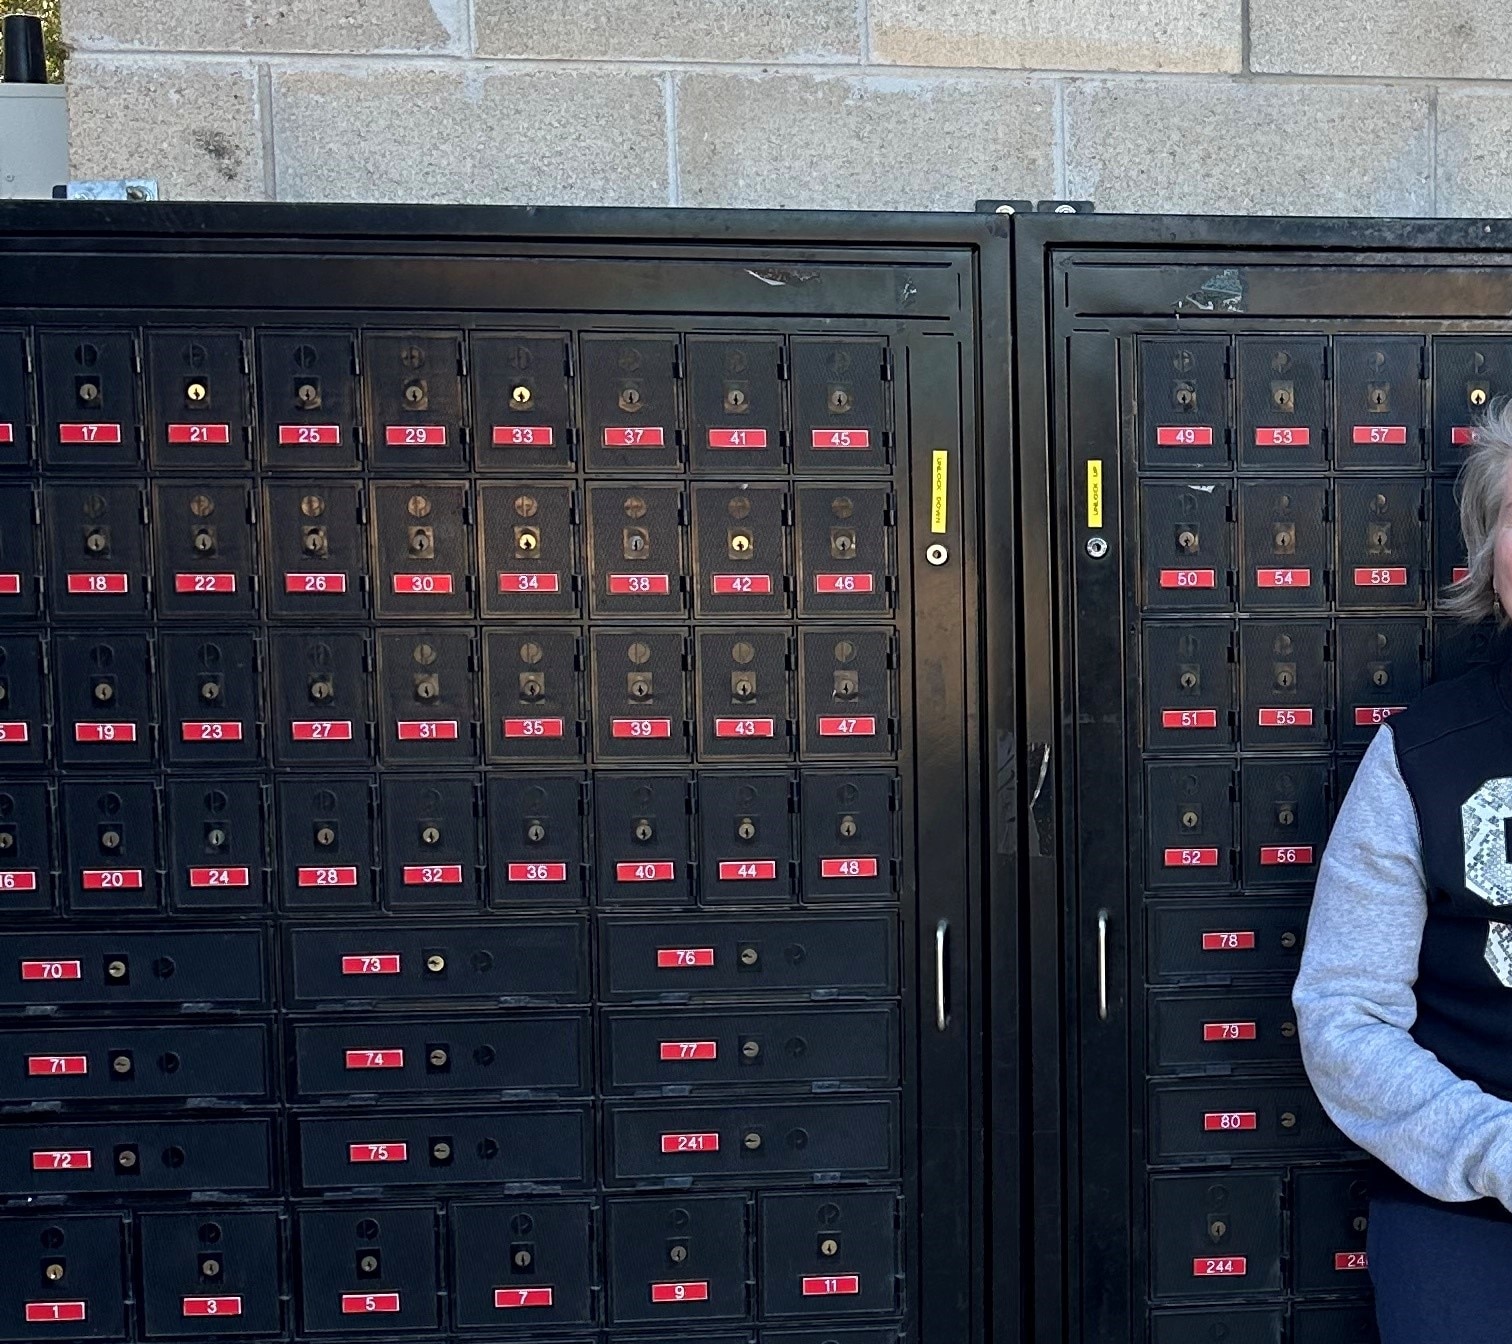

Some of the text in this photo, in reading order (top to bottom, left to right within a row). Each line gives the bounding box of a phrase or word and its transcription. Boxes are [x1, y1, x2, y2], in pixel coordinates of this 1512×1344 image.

[81, 425, 99, 440] 17
[190, 427, 208, 442] 21
[298, 427, 320, 443] 25
[405, 428, 427, 443] 29
[512, 428, 534, 444] 33
[624, 430, 644, 445] 37
[729, 431, 746, 447] 41
[830, 432, 851, 448] 45
[1175, 429, 1195, 445] 49
[1272, 429, 1293, 444] 53
[1370, 427, 1390, 442] 57
[88, 575, 107, 590] 18
[194, 575, 216, 591] 22
[305, 576, 327, 592] 26
[412, 576, 434, 591] 30
[518, 575, 539, 591] 34
[628, 577, 650, 593] 38
[732, 577, 752, 593] 42
[834, 575, 855, 591] 46
[1177, 571, 1198, 586] 50
[1274, 570, 1293, 586] 54
[1370, 570, 1391, 585] 58
[837, 717, 858, 733] 47
[1181, 712, 1198, 727] 51
[1276, 711, 1296, 726] 55
[96, 725, 115, 741] 19
[201, 723, 223, 739] 23
[311, 723, 332, 739] 27
[419, 723, 437, 739] 31
[523, 720, 544, 736] 35
[630, 722, 652, 737] 39
[735, 721, 755, 737] 43
[1182, 850, 1201, 865] 52
[1277, 849, 1296, 864] 56
[422, 868, 443, 883] 32
[526, 864, 548, 880] 36
[635, 864, 656, 879] 40
[737, 863, 757, 879] 44
[839, 860, 860, 875] 48
[101, 872, 124, 888] 20
[208, 869, 229, 884] 24
[316, 870, 338, 885] 28
[1219, 934, 1238, 949] 78
[360, 958, 381, 973] 73
[675, 951, 696, 967] 76
[41, 963, 63, 979] 70
[1220, 1025, 1239, 1040] 79
[678, 1044, 697, 1059] 77
[48, 1057, 66, 1073] 71
[365, 1052, 384, 1068] 74
[1220, 1113, 1241, 1129] 80
[678, 1136, 704, 1151] 241
[366, 1145, 389, 1160] 75
[51, 1153, 72, 1169] 72
[1206, 1258, 1234, 1274] 244
[1347, 1254, 1369, 1269] 24
[674, 1283, 685, 1299] 9
[824, 1278, 837, 1293] 11
[365, 1296, 376, 1312] 5
[517, 1290, 530, 1306] 7
[52, 1304, 59, 1320] 1
[207, 1299, 218, 1315] 3
